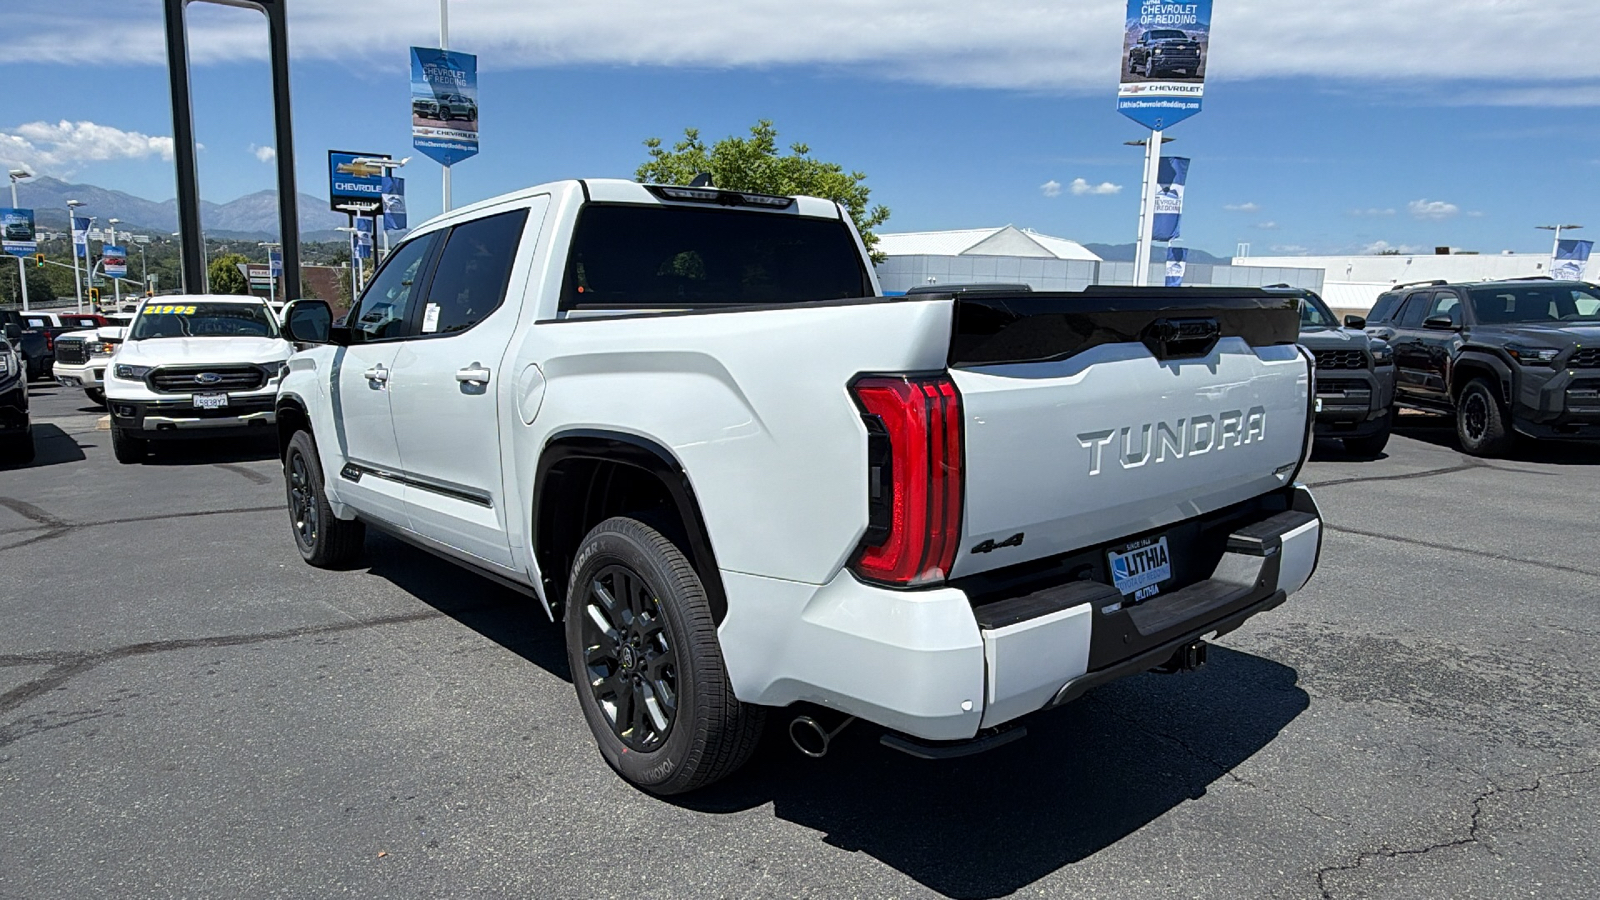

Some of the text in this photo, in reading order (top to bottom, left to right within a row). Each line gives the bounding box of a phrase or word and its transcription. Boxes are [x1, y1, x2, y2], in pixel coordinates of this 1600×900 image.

[1141, 4, 1198, 14] CHEVROLET
[1140, 14, 1197, 24] OF REDDING
[422, 66, 466, 79] CHEVROLET
[422, 74, 467, 86] OF REDDING
[1120, 100, 1199, 109] LithiaChevroletRedding.com
[436, 130, 476, 139] CHEVROLET
[335, 182, 383, 193] CHEVROLE
[143, 305, 197, 315] 21995
[1076, 405, 1266, 476] TUNDRA
[1126, 541, 1140, 551] SINCE
[1124, 545, 1168, 577] LITHIA
